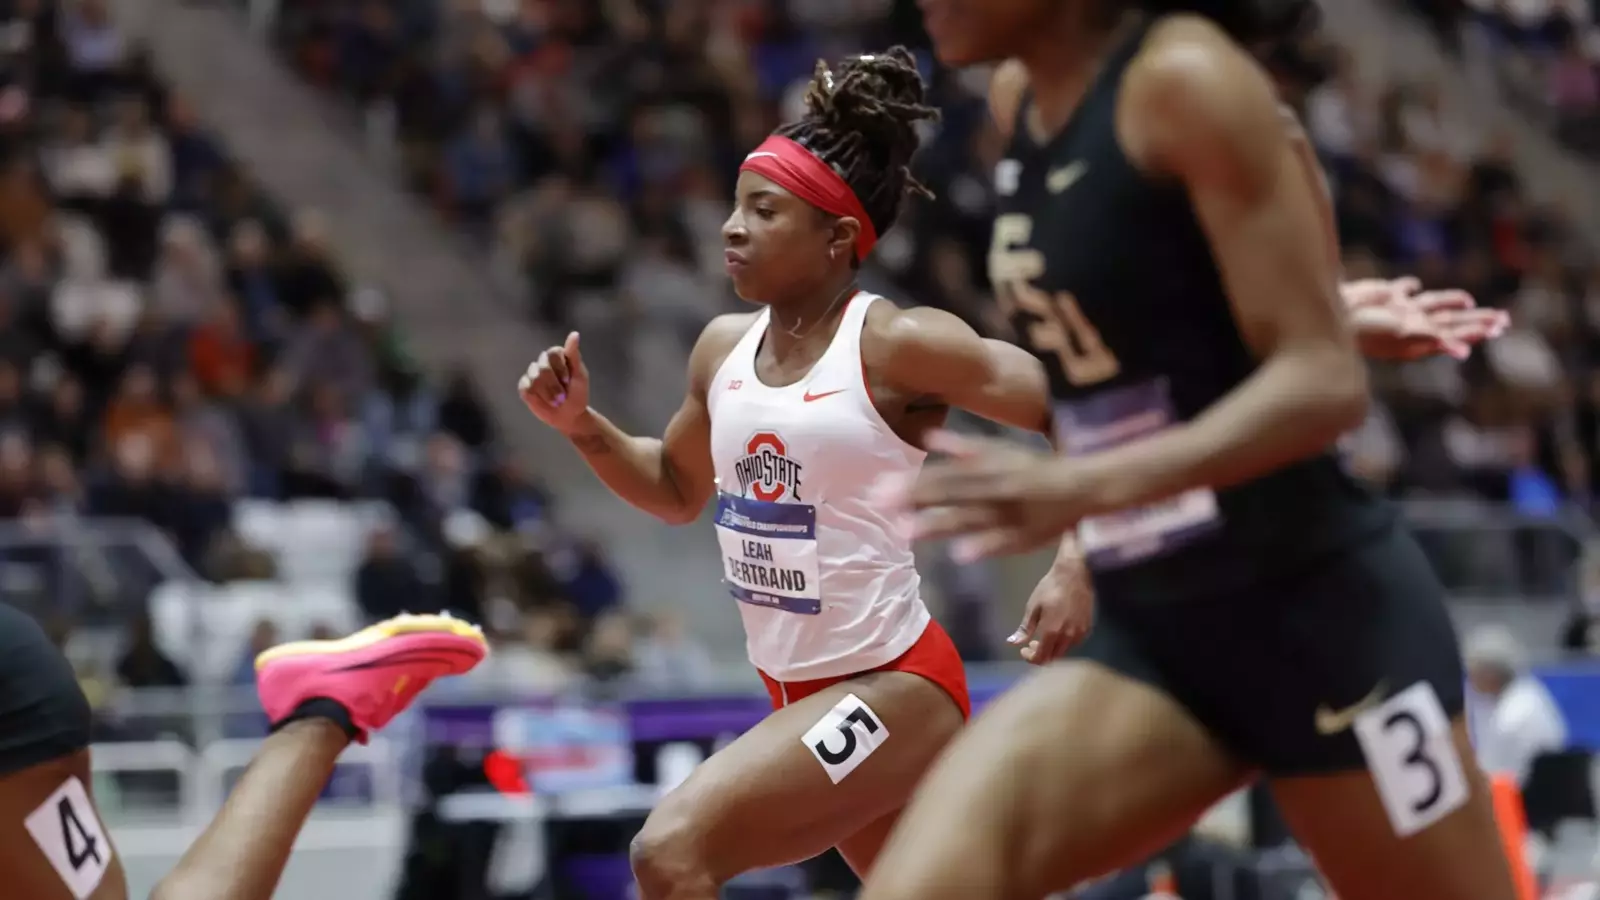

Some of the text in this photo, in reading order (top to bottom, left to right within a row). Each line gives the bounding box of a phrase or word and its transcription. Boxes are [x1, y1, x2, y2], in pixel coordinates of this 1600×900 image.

[742, 540, 774, 562] LEAH
[814, 706, 879, 766] 5
[1383, 711, 1442, 813] 3
[57, 796, 102, 871] 4
